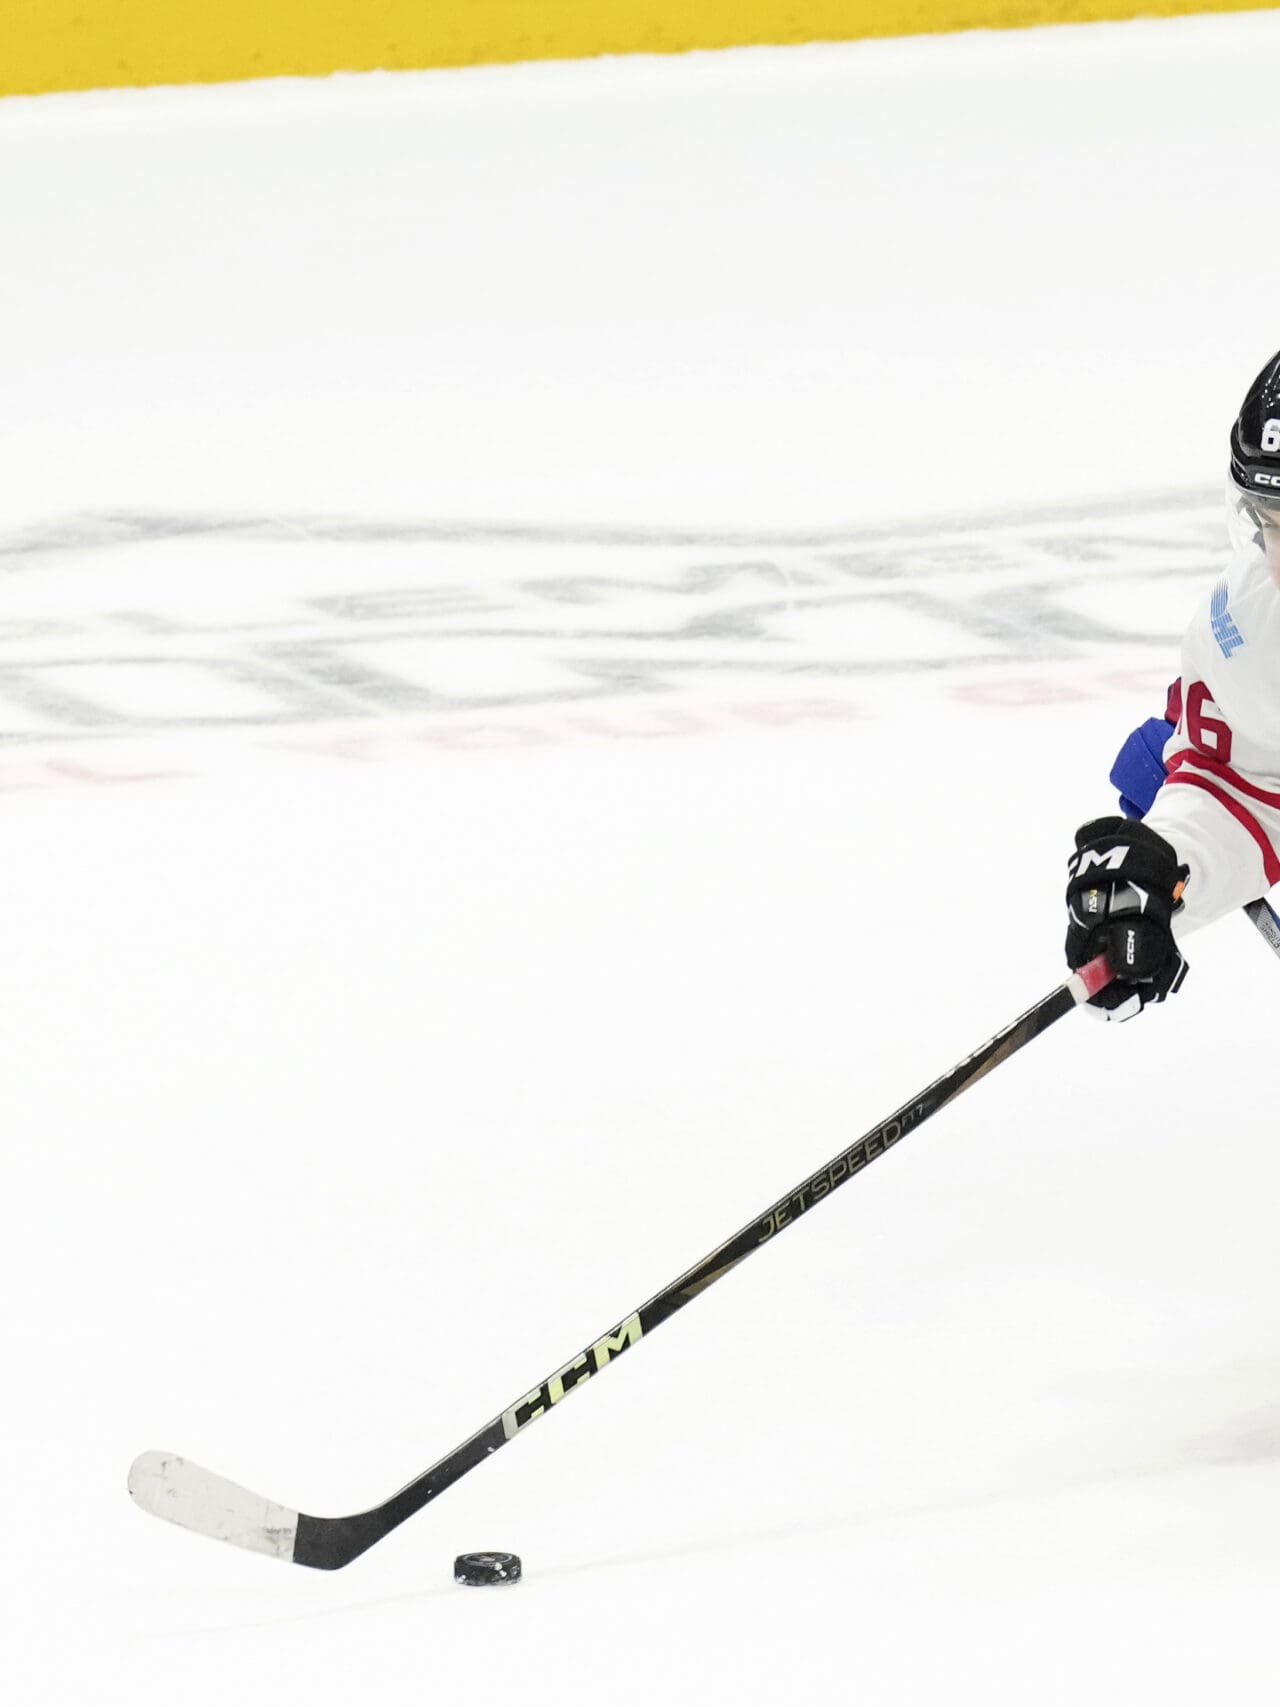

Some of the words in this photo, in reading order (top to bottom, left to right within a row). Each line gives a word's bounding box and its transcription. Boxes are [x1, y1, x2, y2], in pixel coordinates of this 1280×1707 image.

[1177, 680, 1233, 765] 6
[1126, 929, 1136, 966] CCM
[758, 1120, 904, 1243] JETSPEED
[502, 1311, 645, 1441] CCM
